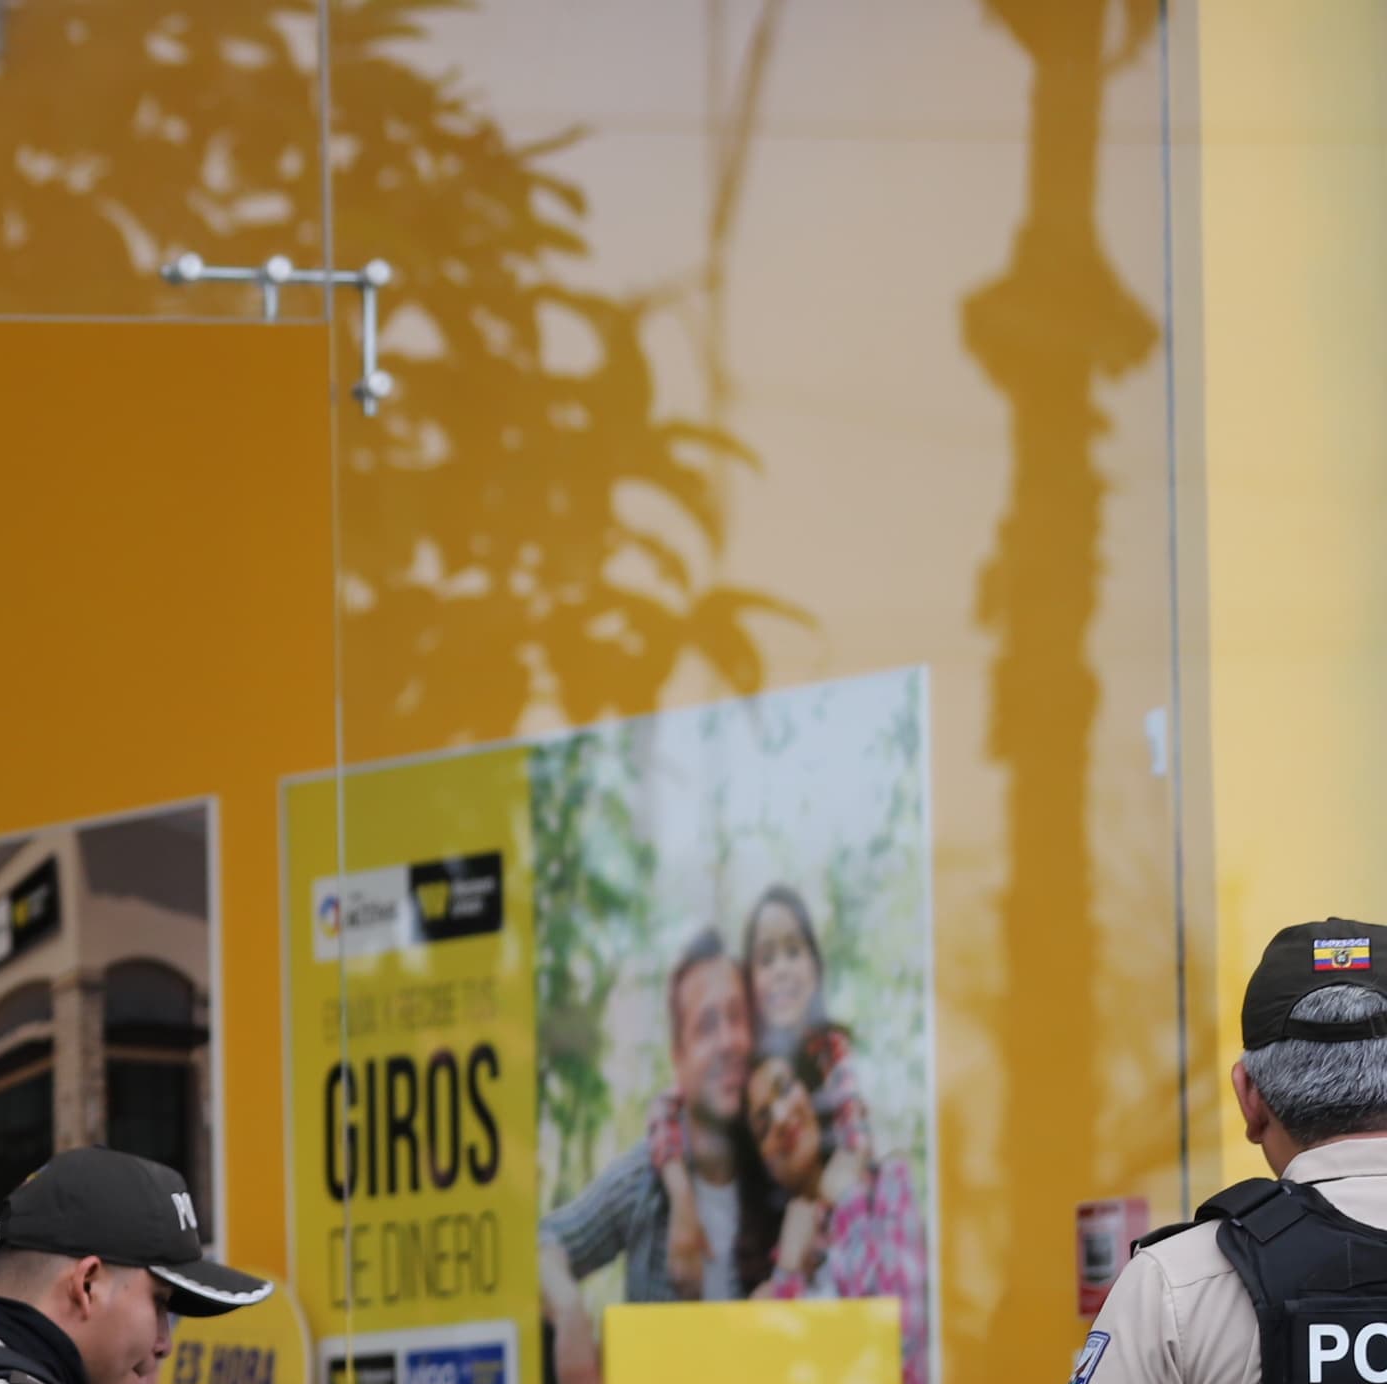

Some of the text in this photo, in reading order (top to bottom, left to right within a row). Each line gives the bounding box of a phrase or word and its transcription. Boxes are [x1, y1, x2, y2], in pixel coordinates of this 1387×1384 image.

[323, 1043, 500, 1203] GIROS
[328, 1209, 500, 1310] DE DINERO
